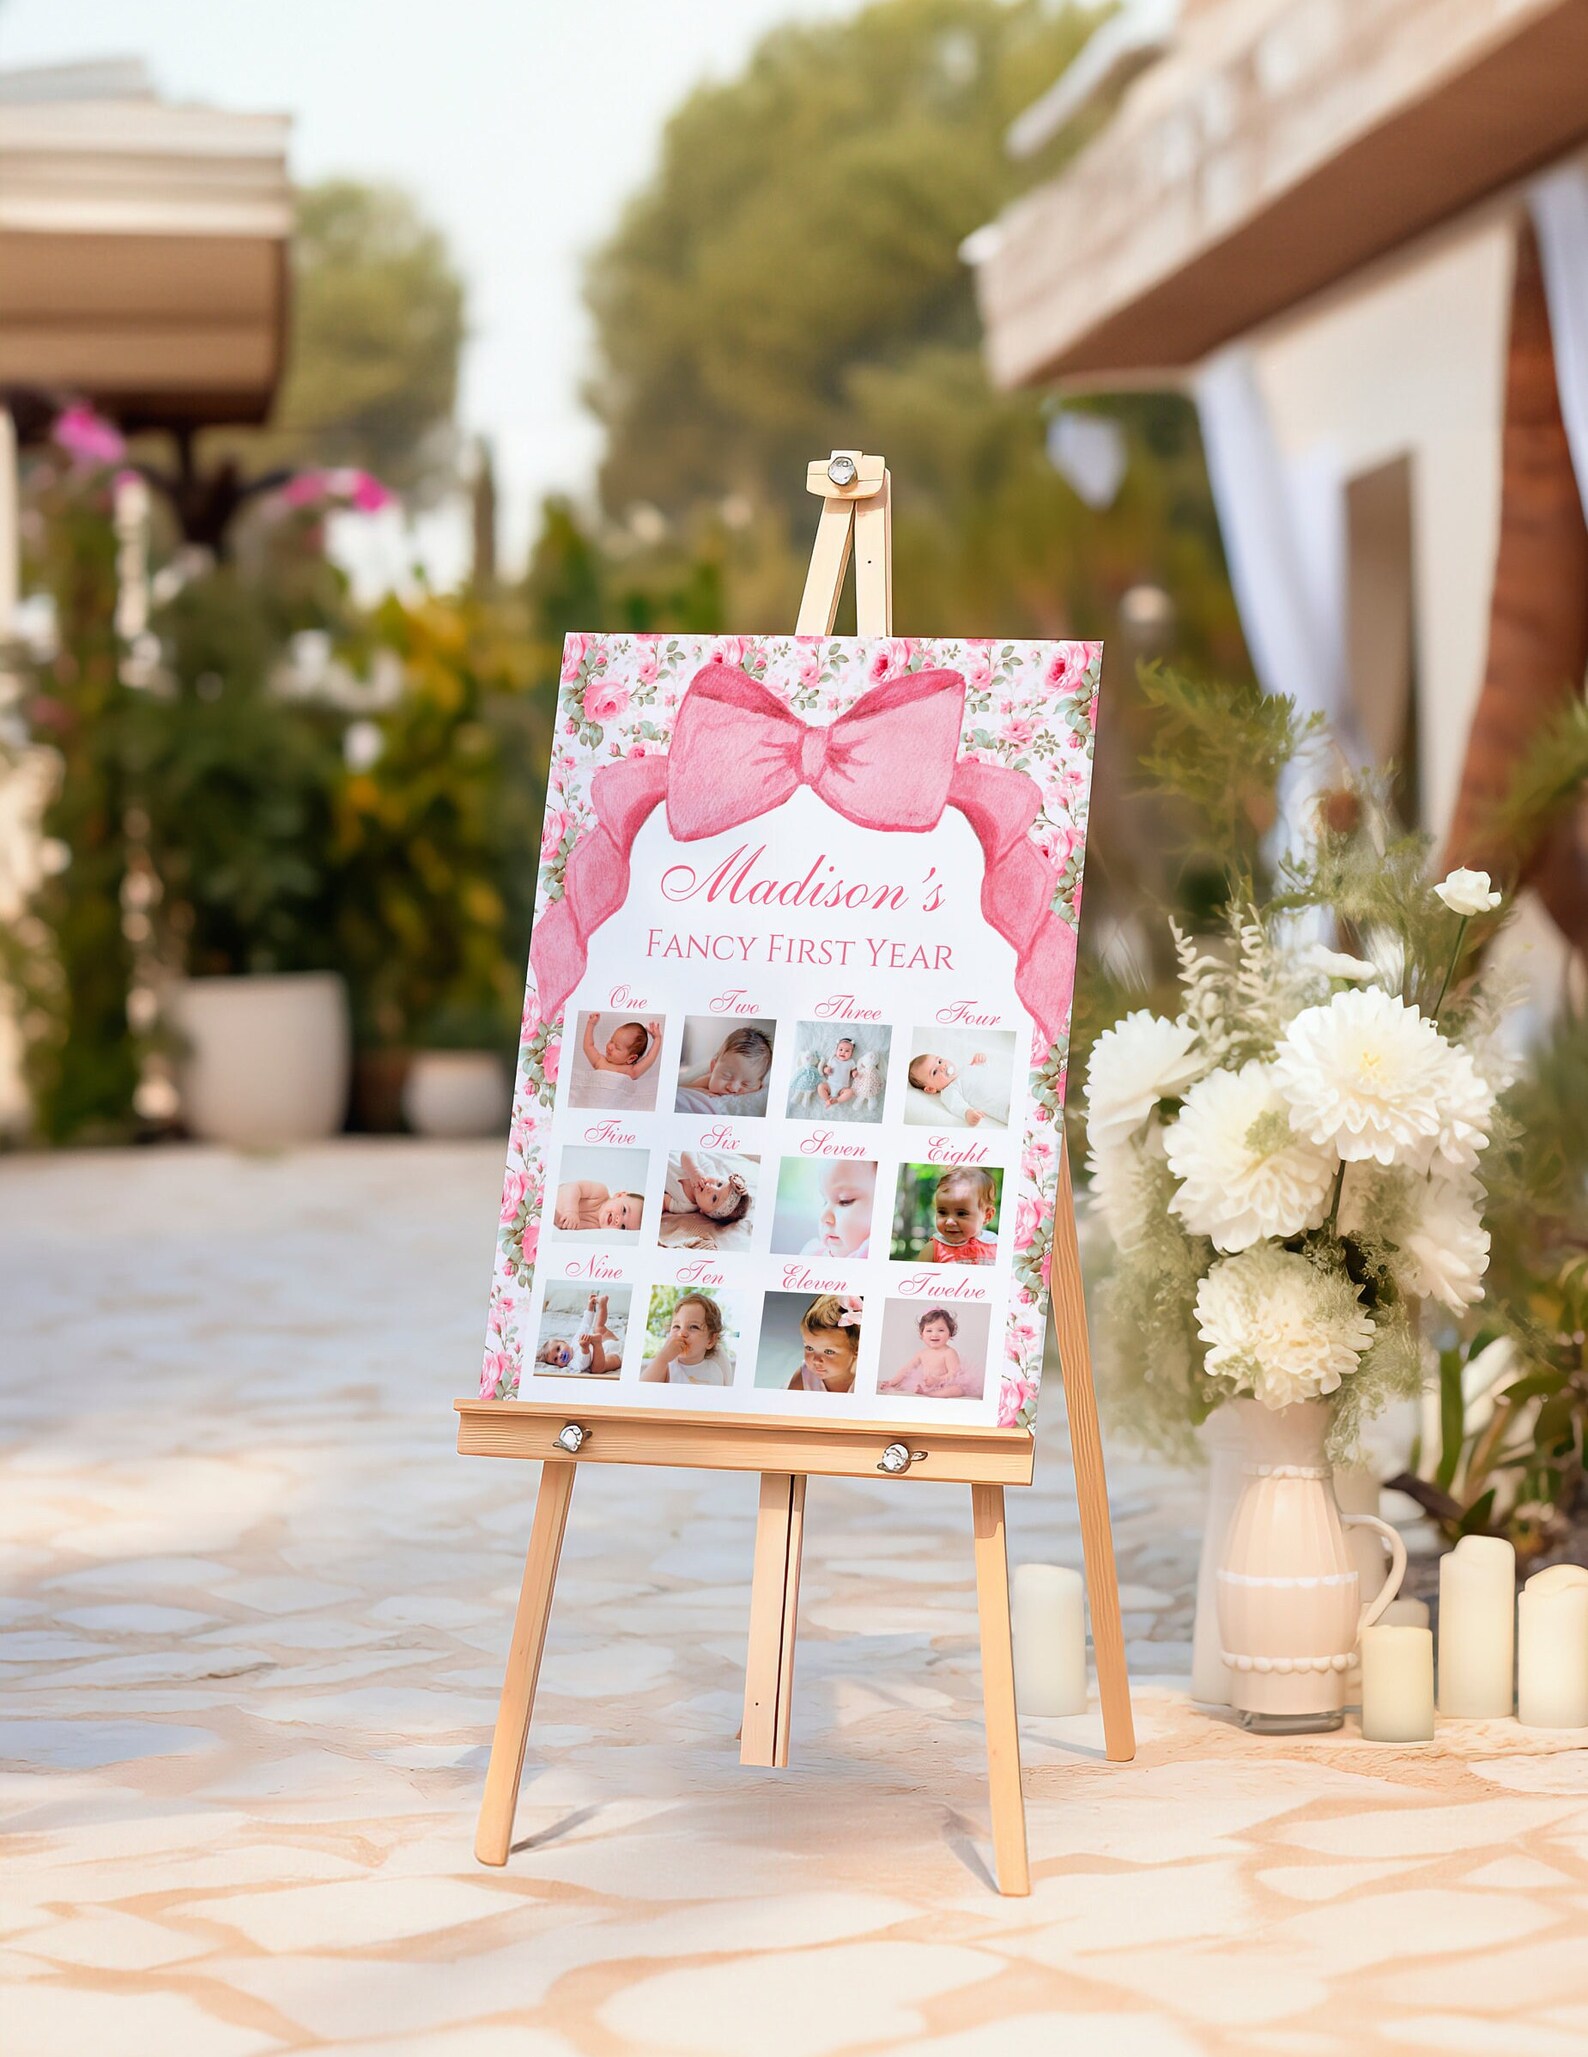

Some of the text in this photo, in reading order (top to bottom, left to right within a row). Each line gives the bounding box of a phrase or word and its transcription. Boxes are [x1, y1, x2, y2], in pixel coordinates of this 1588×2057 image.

[660, 843, 946, 912] Madison's
[645, 928, 955, 971] FANCY FIRST YEAR
[608, 984, 648, 1010] One
[709, 989, 760, 1015] Two
[814, 994, 882, 1021] Three
[935, 1001, 1001, 1026] Four
[584, 1119, 637, 1145] Five
[700, 1124, 741, 1151] Six
[799, 1129, 866, 1157] Seven
[927, 1135, 989, 1168] Eight
[565, 1254, 623, 1280] Nine
[676, 1259, 725, 1286] Ten
[781, 1264, 847, 1291] Eleven
[898, 1272, 986, 1299] Twelve
